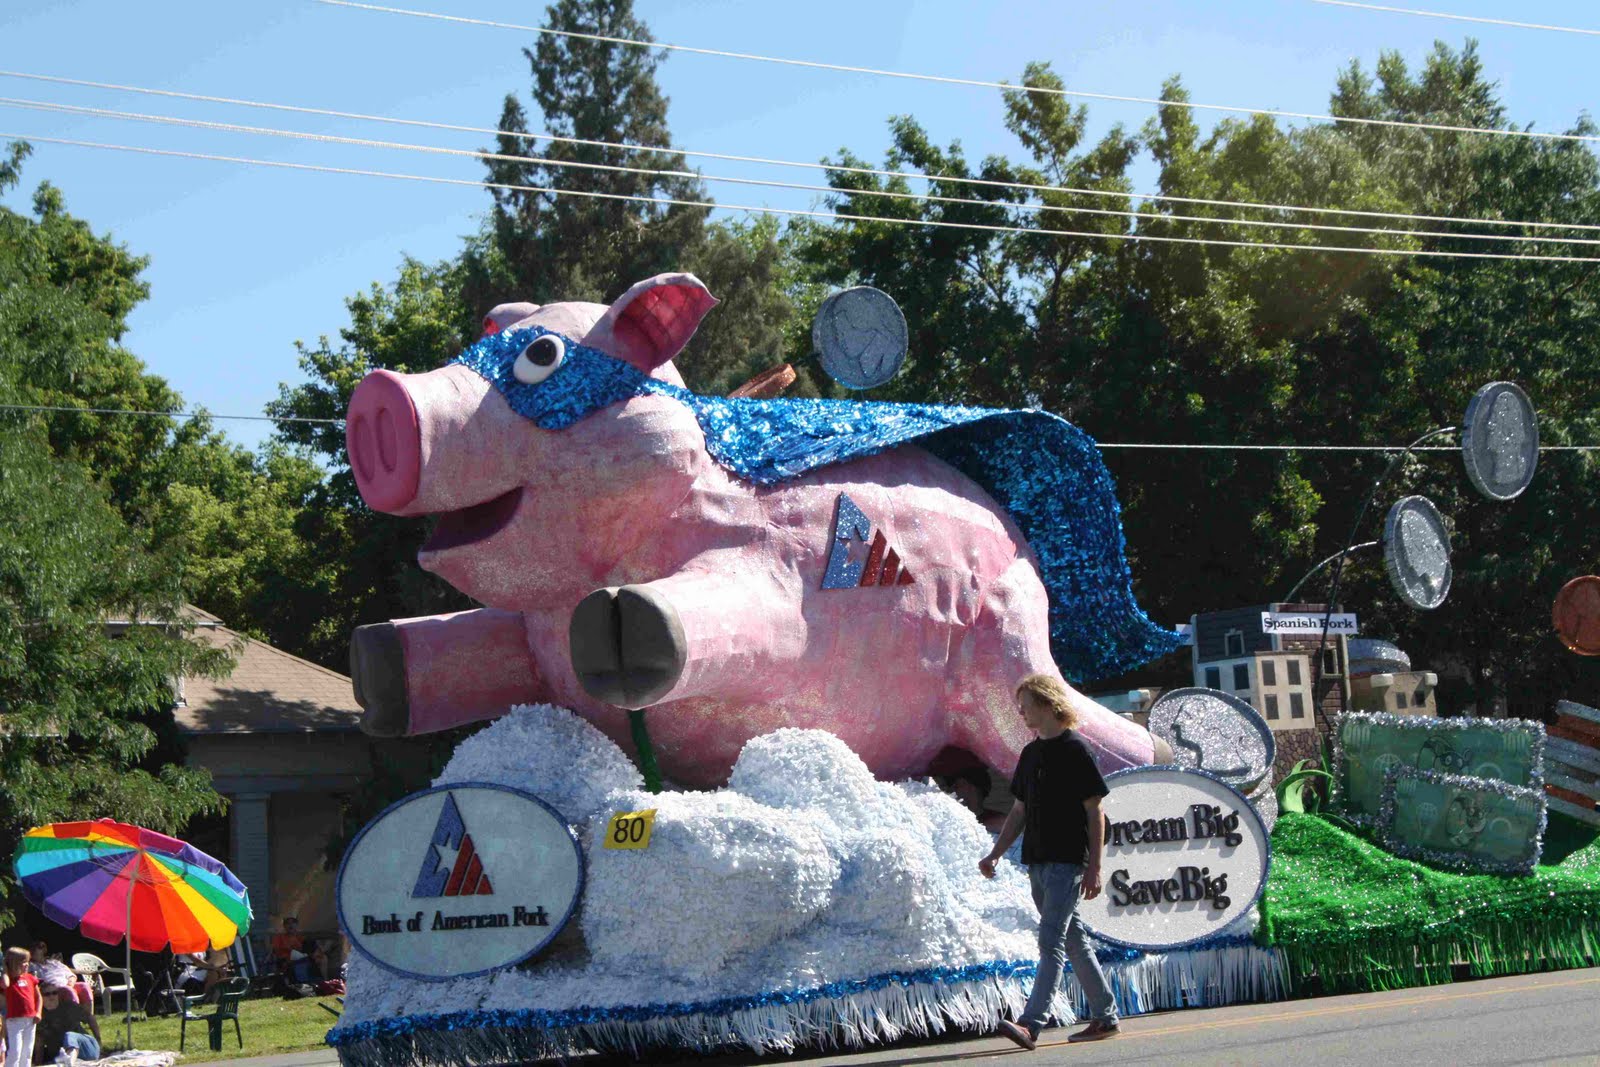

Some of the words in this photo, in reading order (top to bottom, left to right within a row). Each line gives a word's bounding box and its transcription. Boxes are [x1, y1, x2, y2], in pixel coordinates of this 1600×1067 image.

[1264, 617, 1317, 630] Spanish
[1319, 617, 1354, 629] Fork
[613, 817, 645, 843] 80
[1190, 803, 1243, 847] Big
[361, 914, 402, 935] Bank
[406, 911, 423, 932] of
[431, 910, 510, 931] American
[512, 905, 549, 926] Fork
